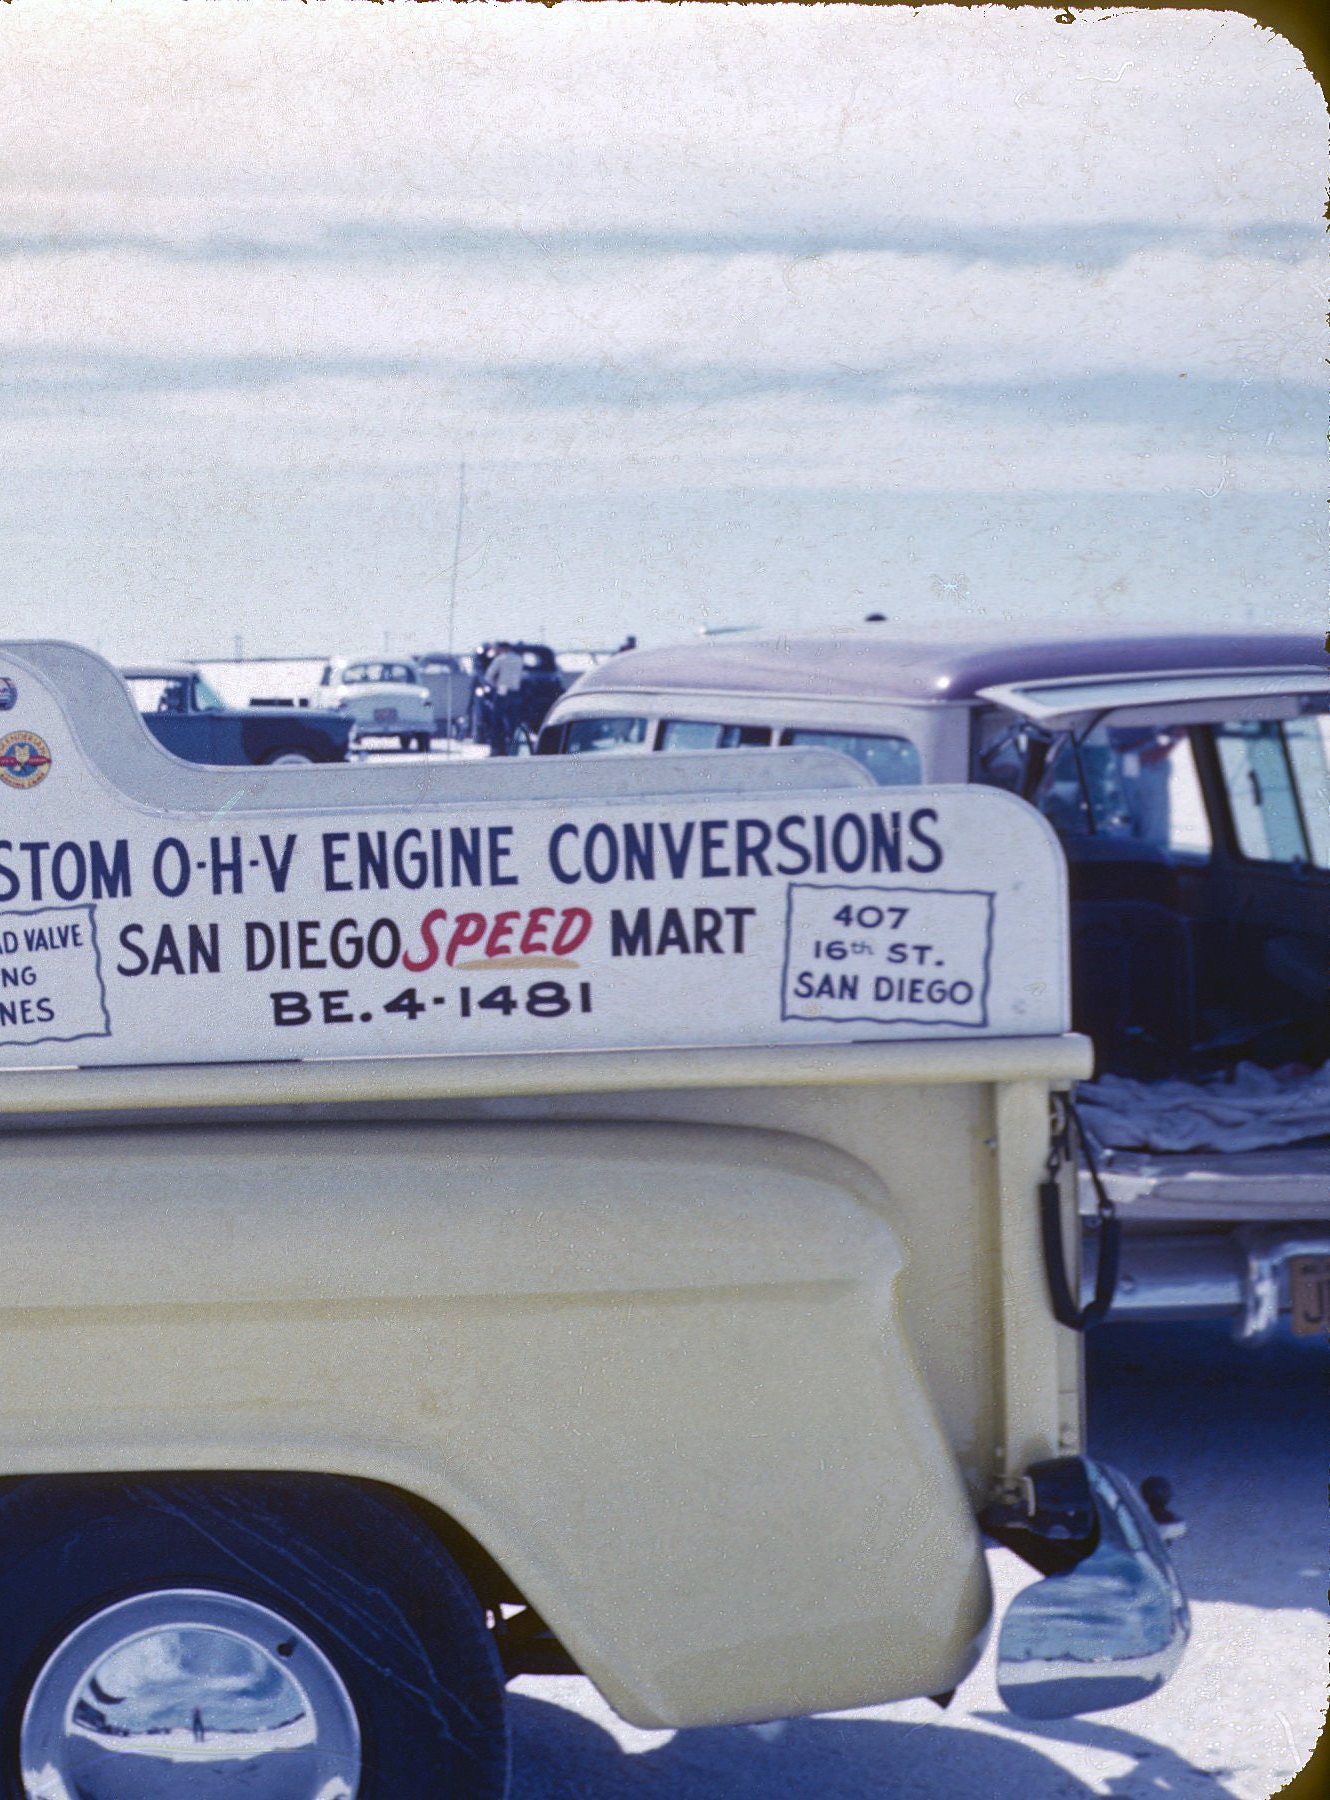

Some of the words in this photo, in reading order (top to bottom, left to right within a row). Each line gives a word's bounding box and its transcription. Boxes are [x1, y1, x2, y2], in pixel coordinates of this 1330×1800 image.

[153, 834, 296, 897] O-H-V
[323, 827, 518, 892] ENGINE
[549, 808, 943, 884] CONVERSIONS
[833, 904, 909, 930] 407
[24, 924, 82, 951] VALVE
[117, 924, 220, 976] SAN
[246, 918, 401, 971] DIEGO
[402, 907, 592, 972] SPEED
[611, 908, 755, 956] MART
[815, 941, 873, 961] 16th
[887, 943, 945, 967] ST.
[794, 971, 858, 1001] SAN
[874, 976, 974, 1006] DIEGO
